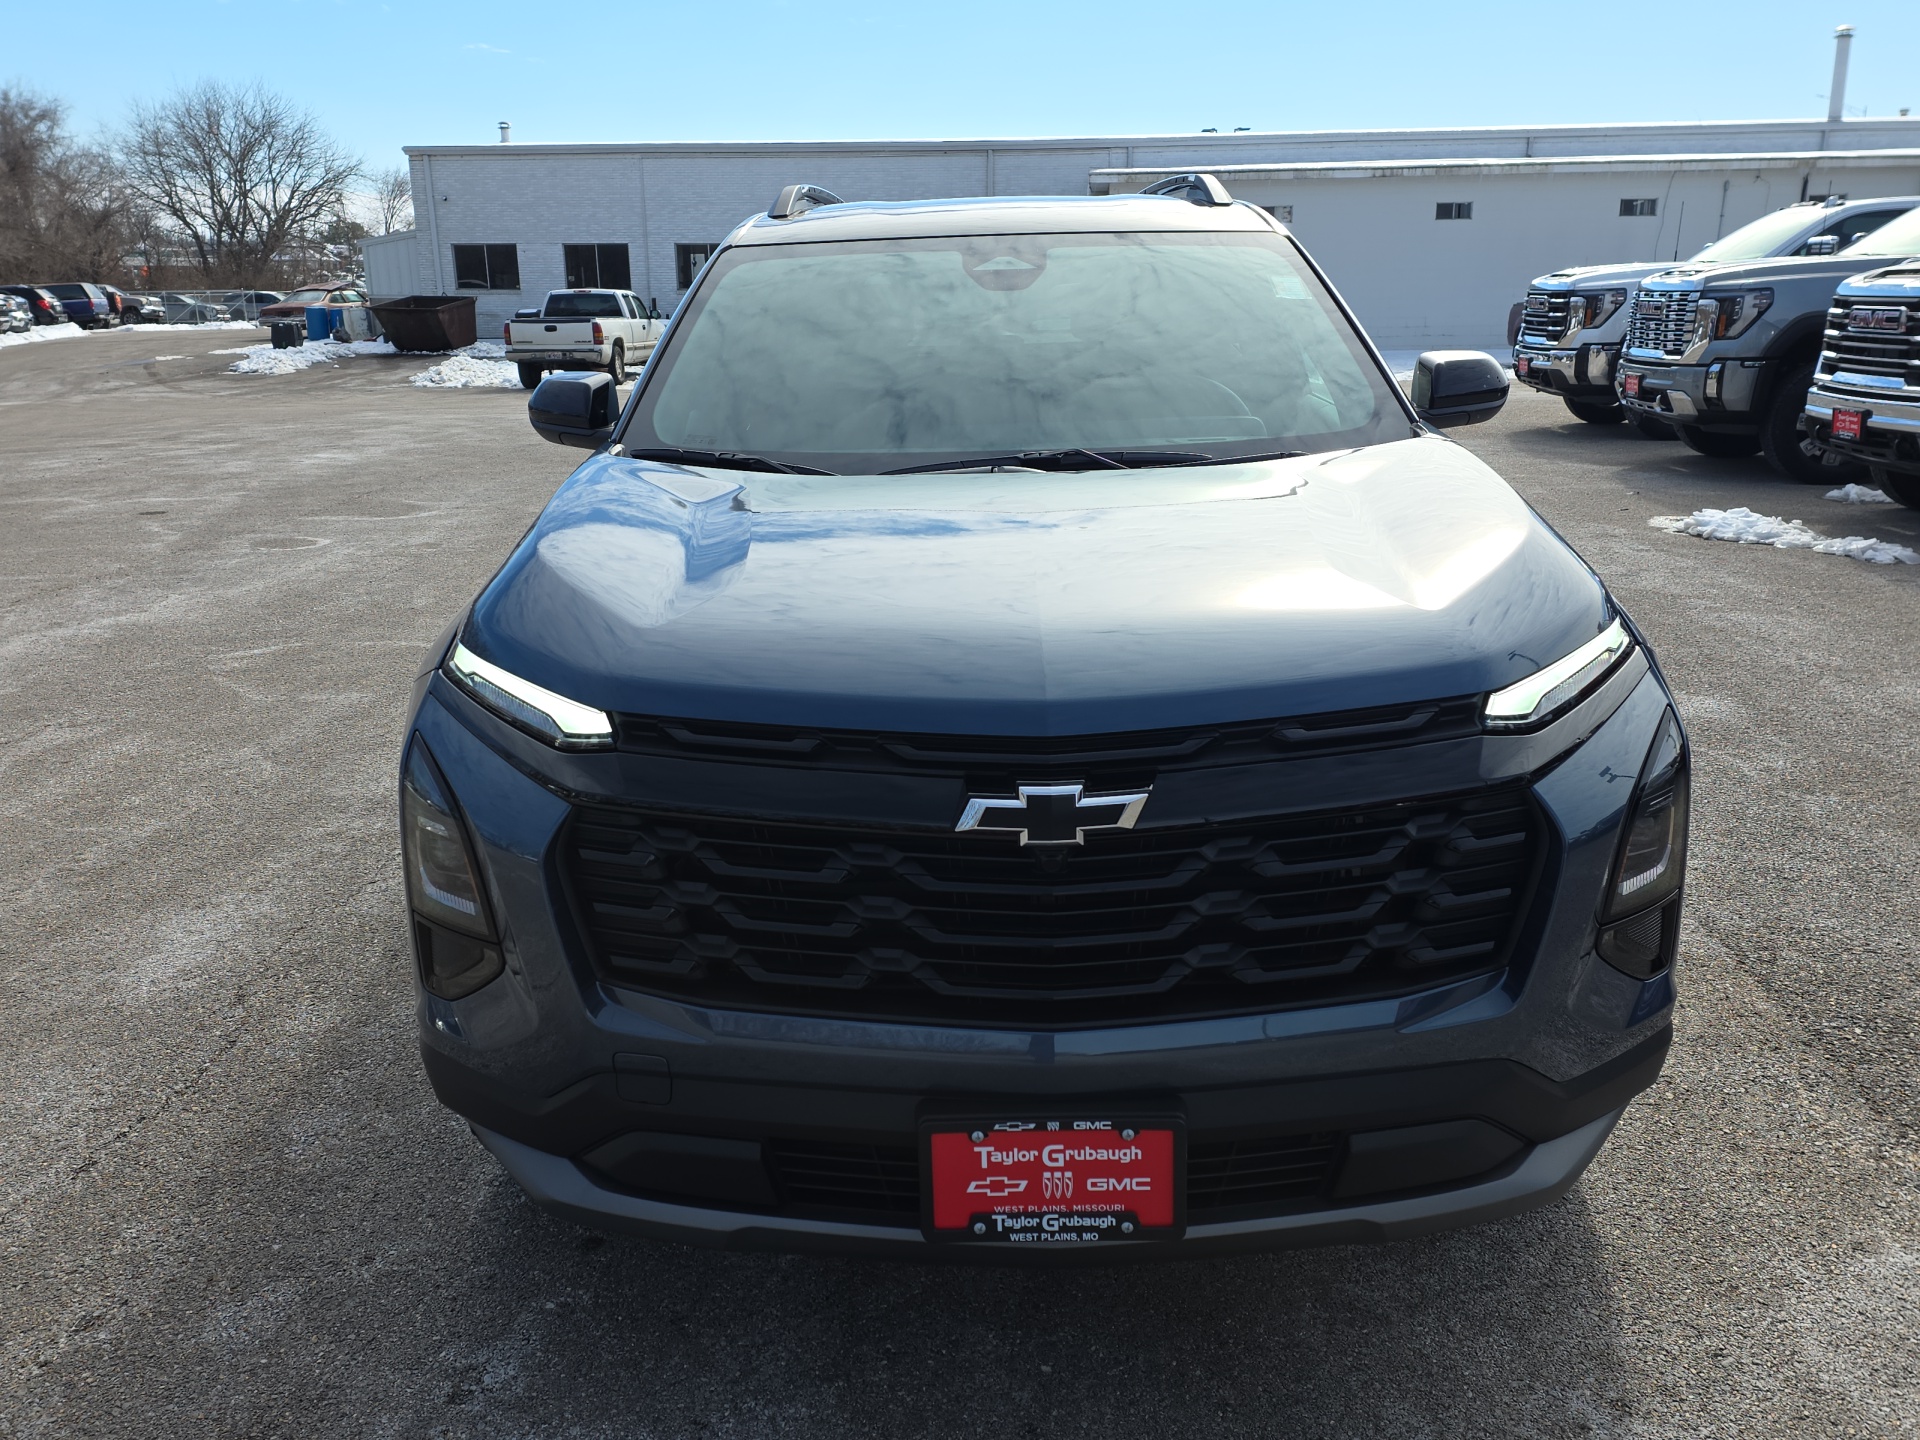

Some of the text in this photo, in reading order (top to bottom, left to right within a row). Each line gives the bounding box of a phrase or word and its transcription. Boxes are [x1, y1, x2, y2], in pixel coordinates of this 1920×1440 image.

[1638, 301, 1662, 314] GMC
[1850, 310, 1900, 328] GMC
[1073, 1121, 1112, 1130] GMC
[973, 1144, 1142, 1169] Taylor Grubaugh
[1086, 1177, 1151, 1191] GMC
[994, 1204, 1125, 1213] WEST PLAINS, MISSOURI
[992, 1213, 1116, 1232] Taylor Grubaugh
[1009, 1232, 1099, 1242] WEST PLAINS, MO
